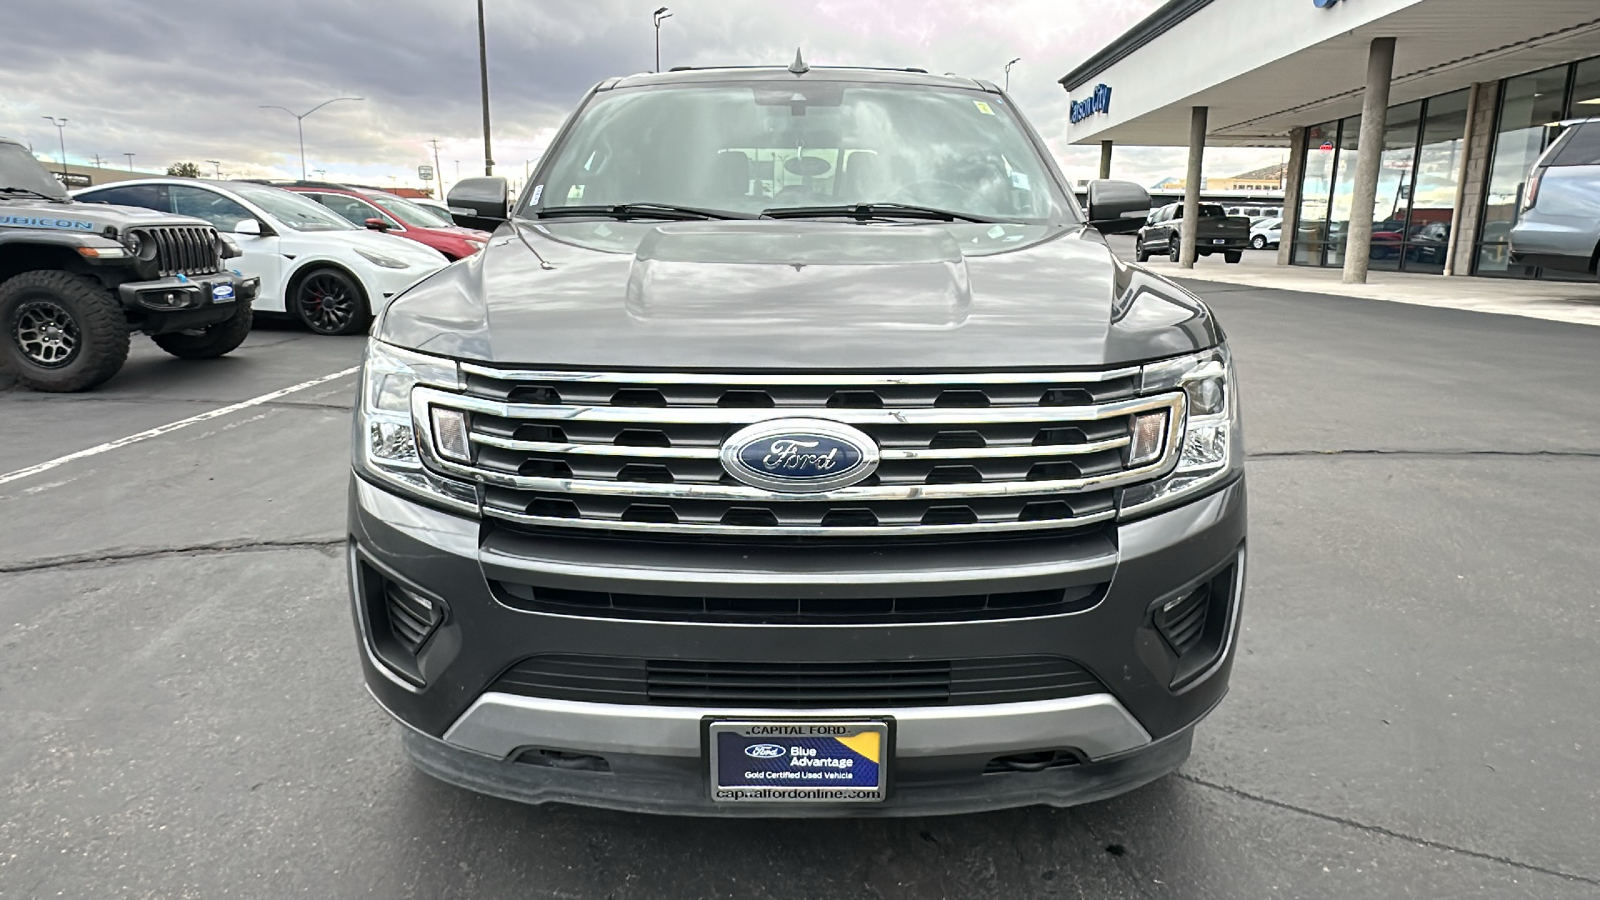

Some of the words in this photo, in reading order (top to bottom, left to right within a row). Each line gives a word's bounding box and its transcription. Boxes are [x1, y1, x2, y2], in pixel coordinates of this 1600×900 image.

[1070, 97, 1094, 123] Carson
[1093, 84, 1112, 114] City
[0, 216, 93, 229] UBICON
[763, 439, 837, 470] Ford
[751, 726, 805, 735] CAPITAL
[809, 726, 846, 735] FORD
[752, 746, 778, 756] Ford
[790, 746, 817, 756] Blue
[790, 757, 853, 768] Advantage
[744, 771, 764, 779] Gold
[766, 771, 800, 779] Certified
[801, 771, 822, 779] Used
[824, 771, 853, 779] Vehicle
